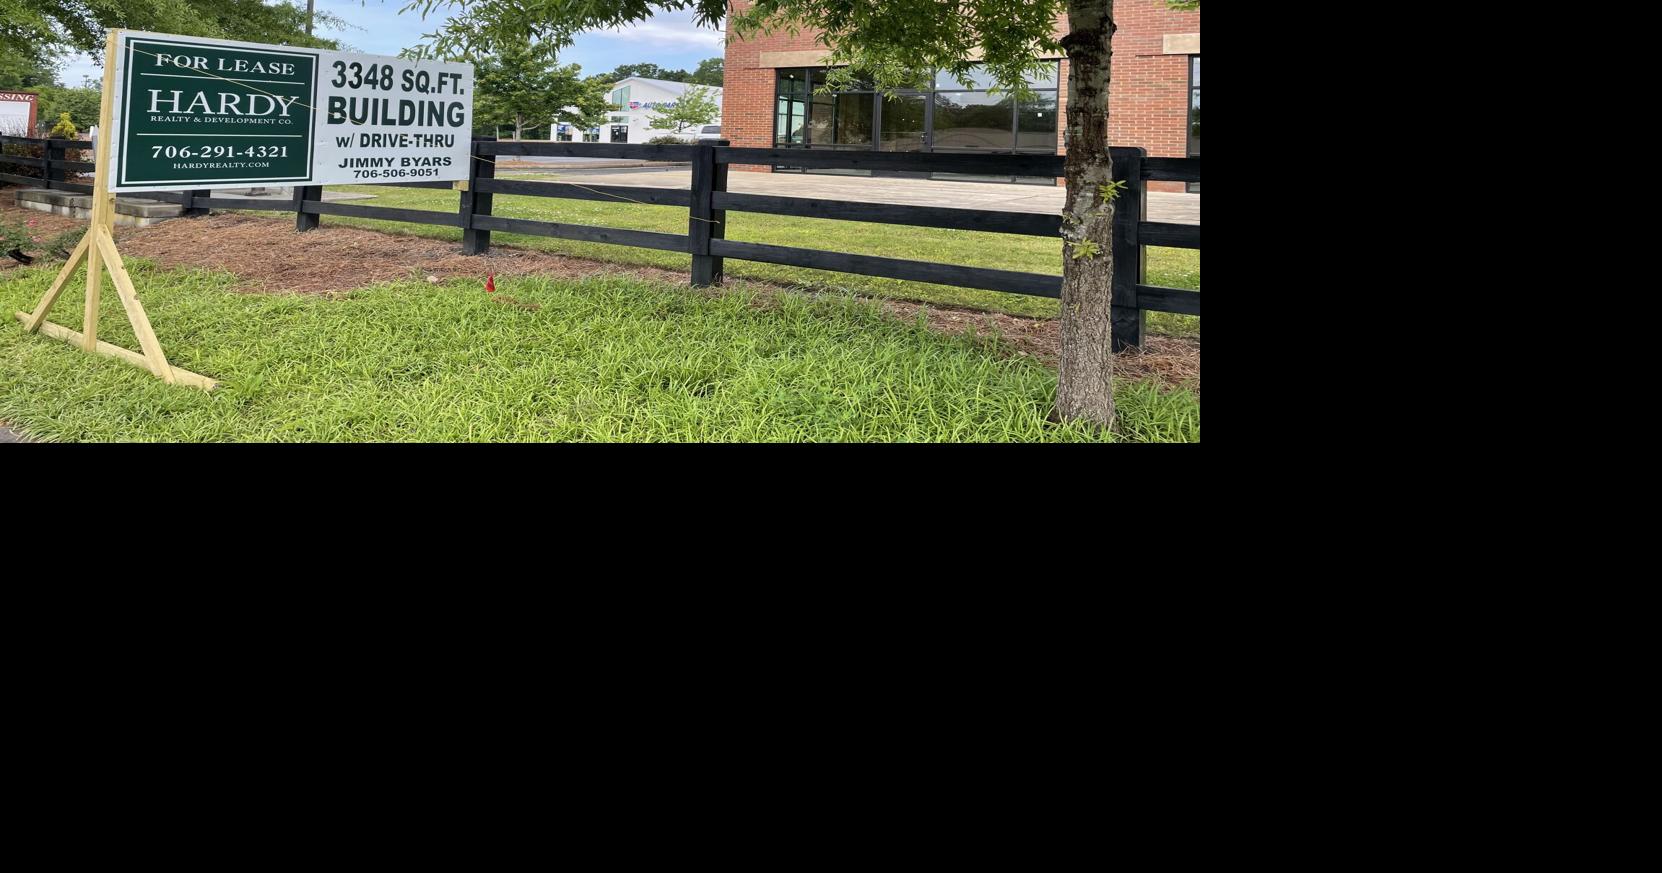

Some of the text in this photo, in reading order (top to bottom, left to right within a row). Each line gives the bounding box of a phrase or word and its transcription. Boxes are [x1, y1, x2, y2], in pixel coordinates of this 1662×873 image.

[156, 53, 295, 76] FOR LEASE
[331, 60, 464, 95] 3348 SQ.FT.
[147, 89, 300, 117] HARDY
[327, 96, 465, 128] BUILDING
[150, 115, 191, 123] REALTY
[204, 116, 276, 125] DEVELOPMENT
[336, 133, 455, 149] w/ DRIVE-THRU
[151, 145, 288, 159] 706-291-4321
[173, 161, 270, 169] HARDYREALTY.COM
[338, 156, 452, 169] JIMMY BYARS
[353, 168, 439, 179] 706-506-9051
